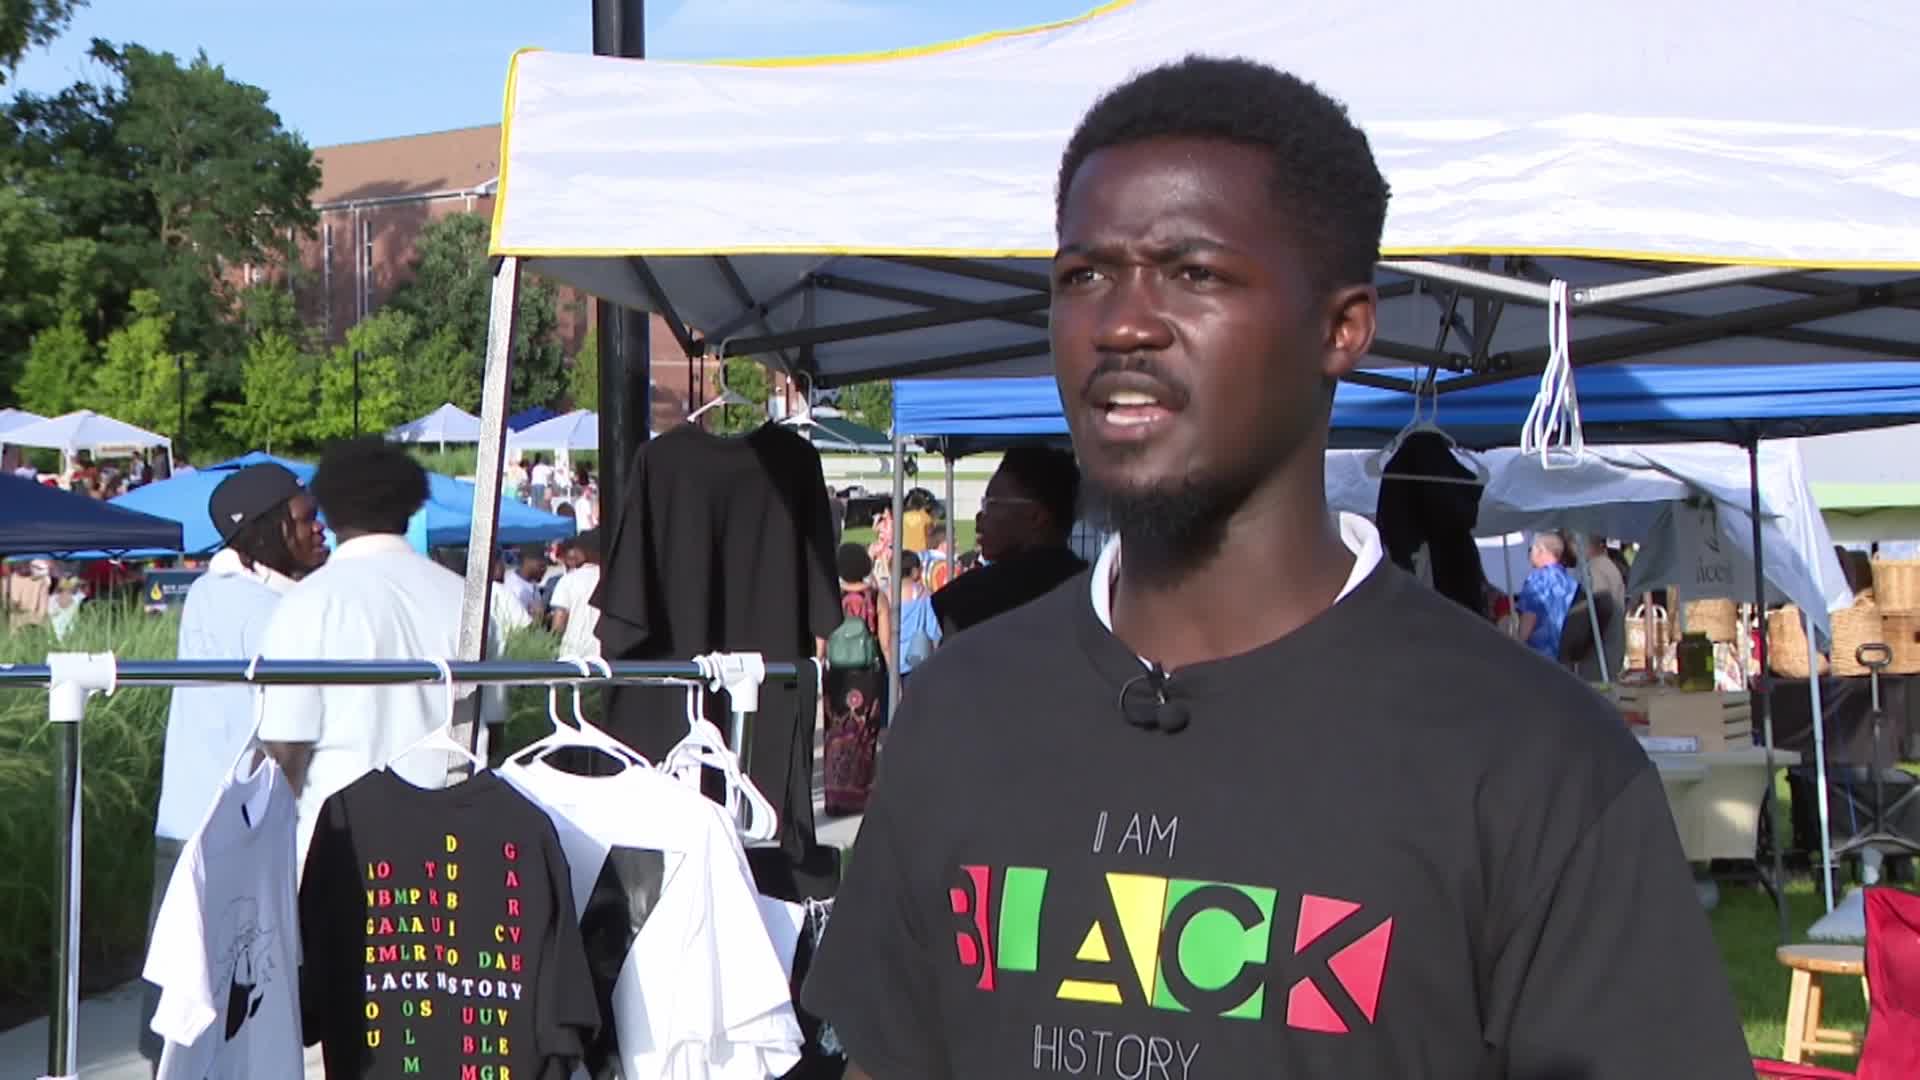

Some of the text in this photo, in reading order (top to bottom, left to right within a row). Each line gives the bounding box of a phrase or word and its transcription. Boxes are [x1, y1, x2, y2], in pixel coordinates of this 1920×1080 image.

[1093, 811, 1179, 858] I AM
[949, 865, 1394, 1034] BLACK
[436, 971, 523, 1000] HSTORY
[1033, 1024, 1199, 1080] HISTORY
